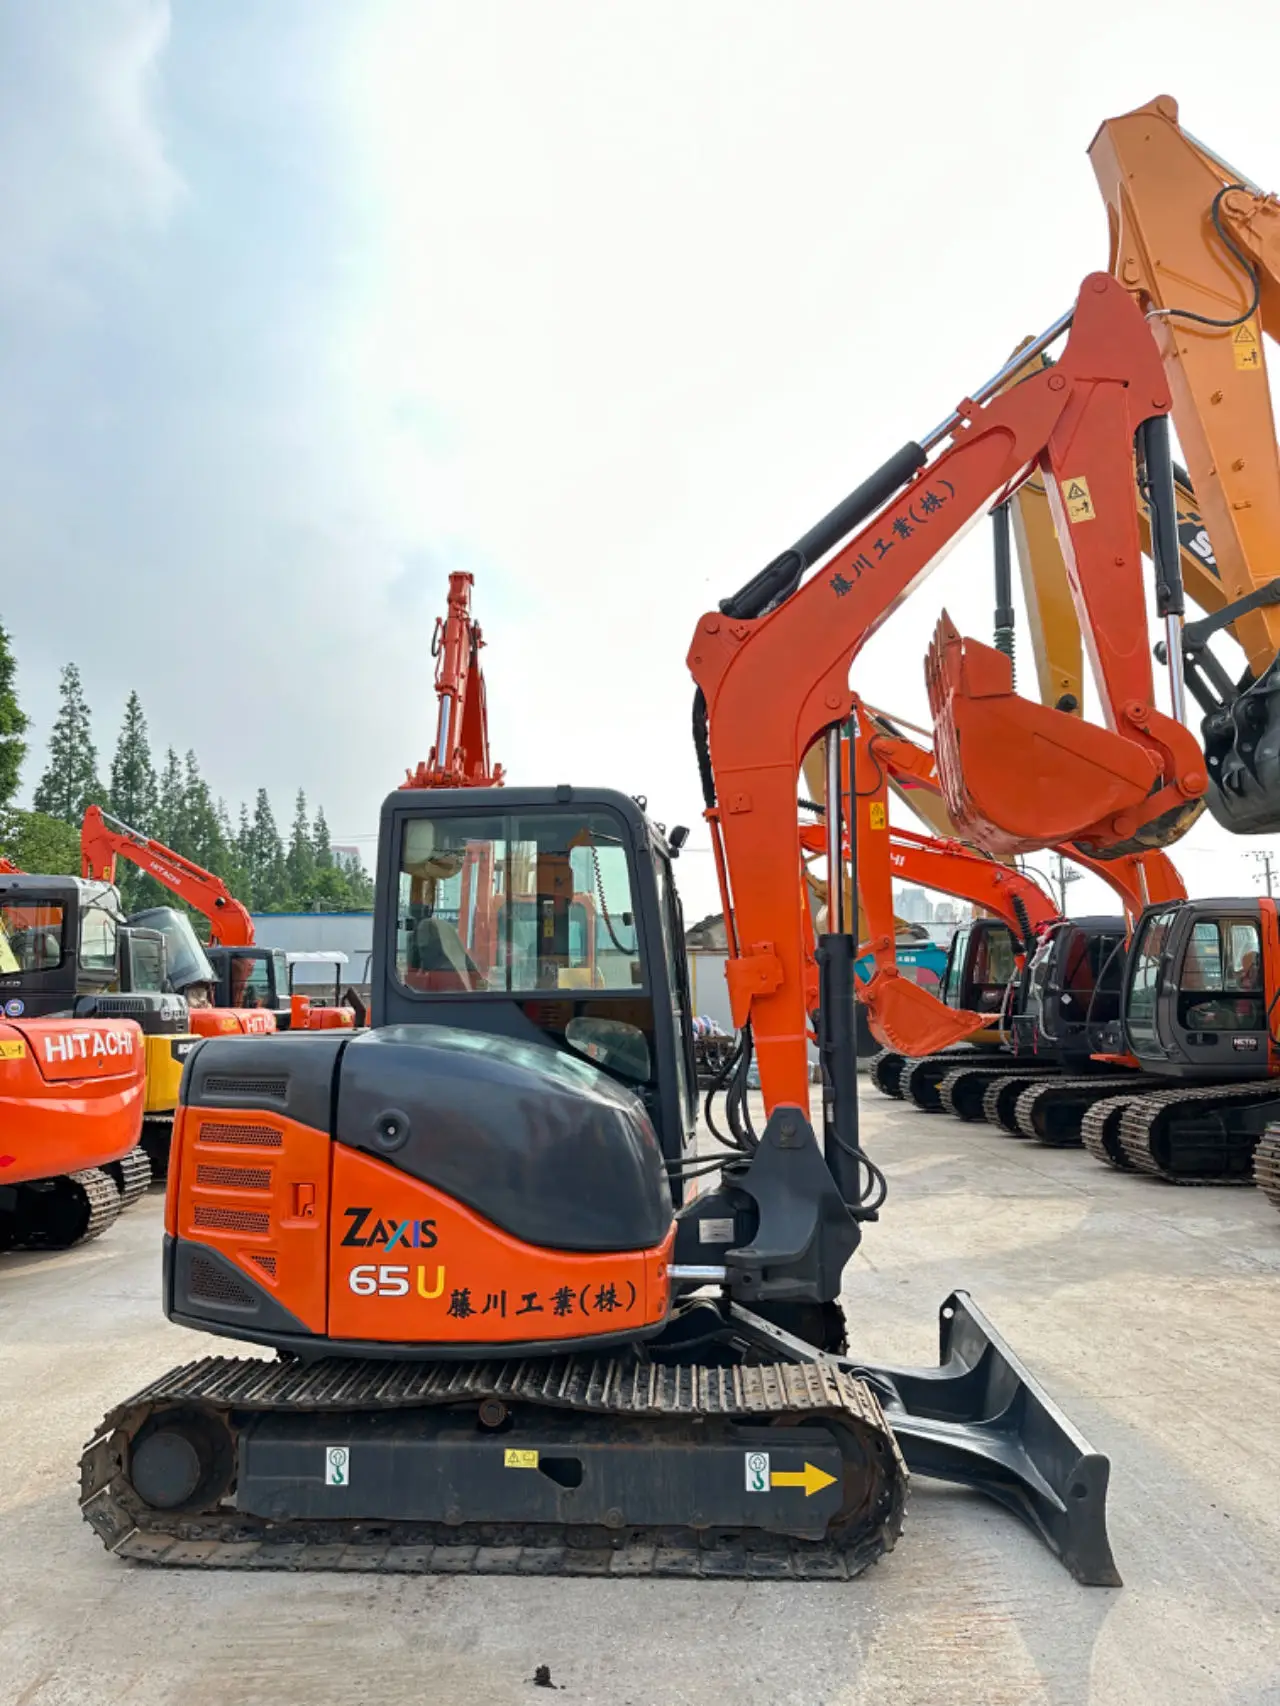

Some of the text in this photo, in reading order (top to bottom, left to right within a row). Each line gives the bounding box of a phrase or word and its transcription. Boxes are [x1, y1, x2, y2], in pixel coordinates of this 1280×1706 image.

[150, 861, 182, 885] HITACHI
[44, 1031, 133, 1063] HITACHI
[340, 1207, 438, 1253] ZAXIS
[348, 1264, 446, 1299] 65 U
[447, 1280, 637, 1319] 藤川工業(株)
